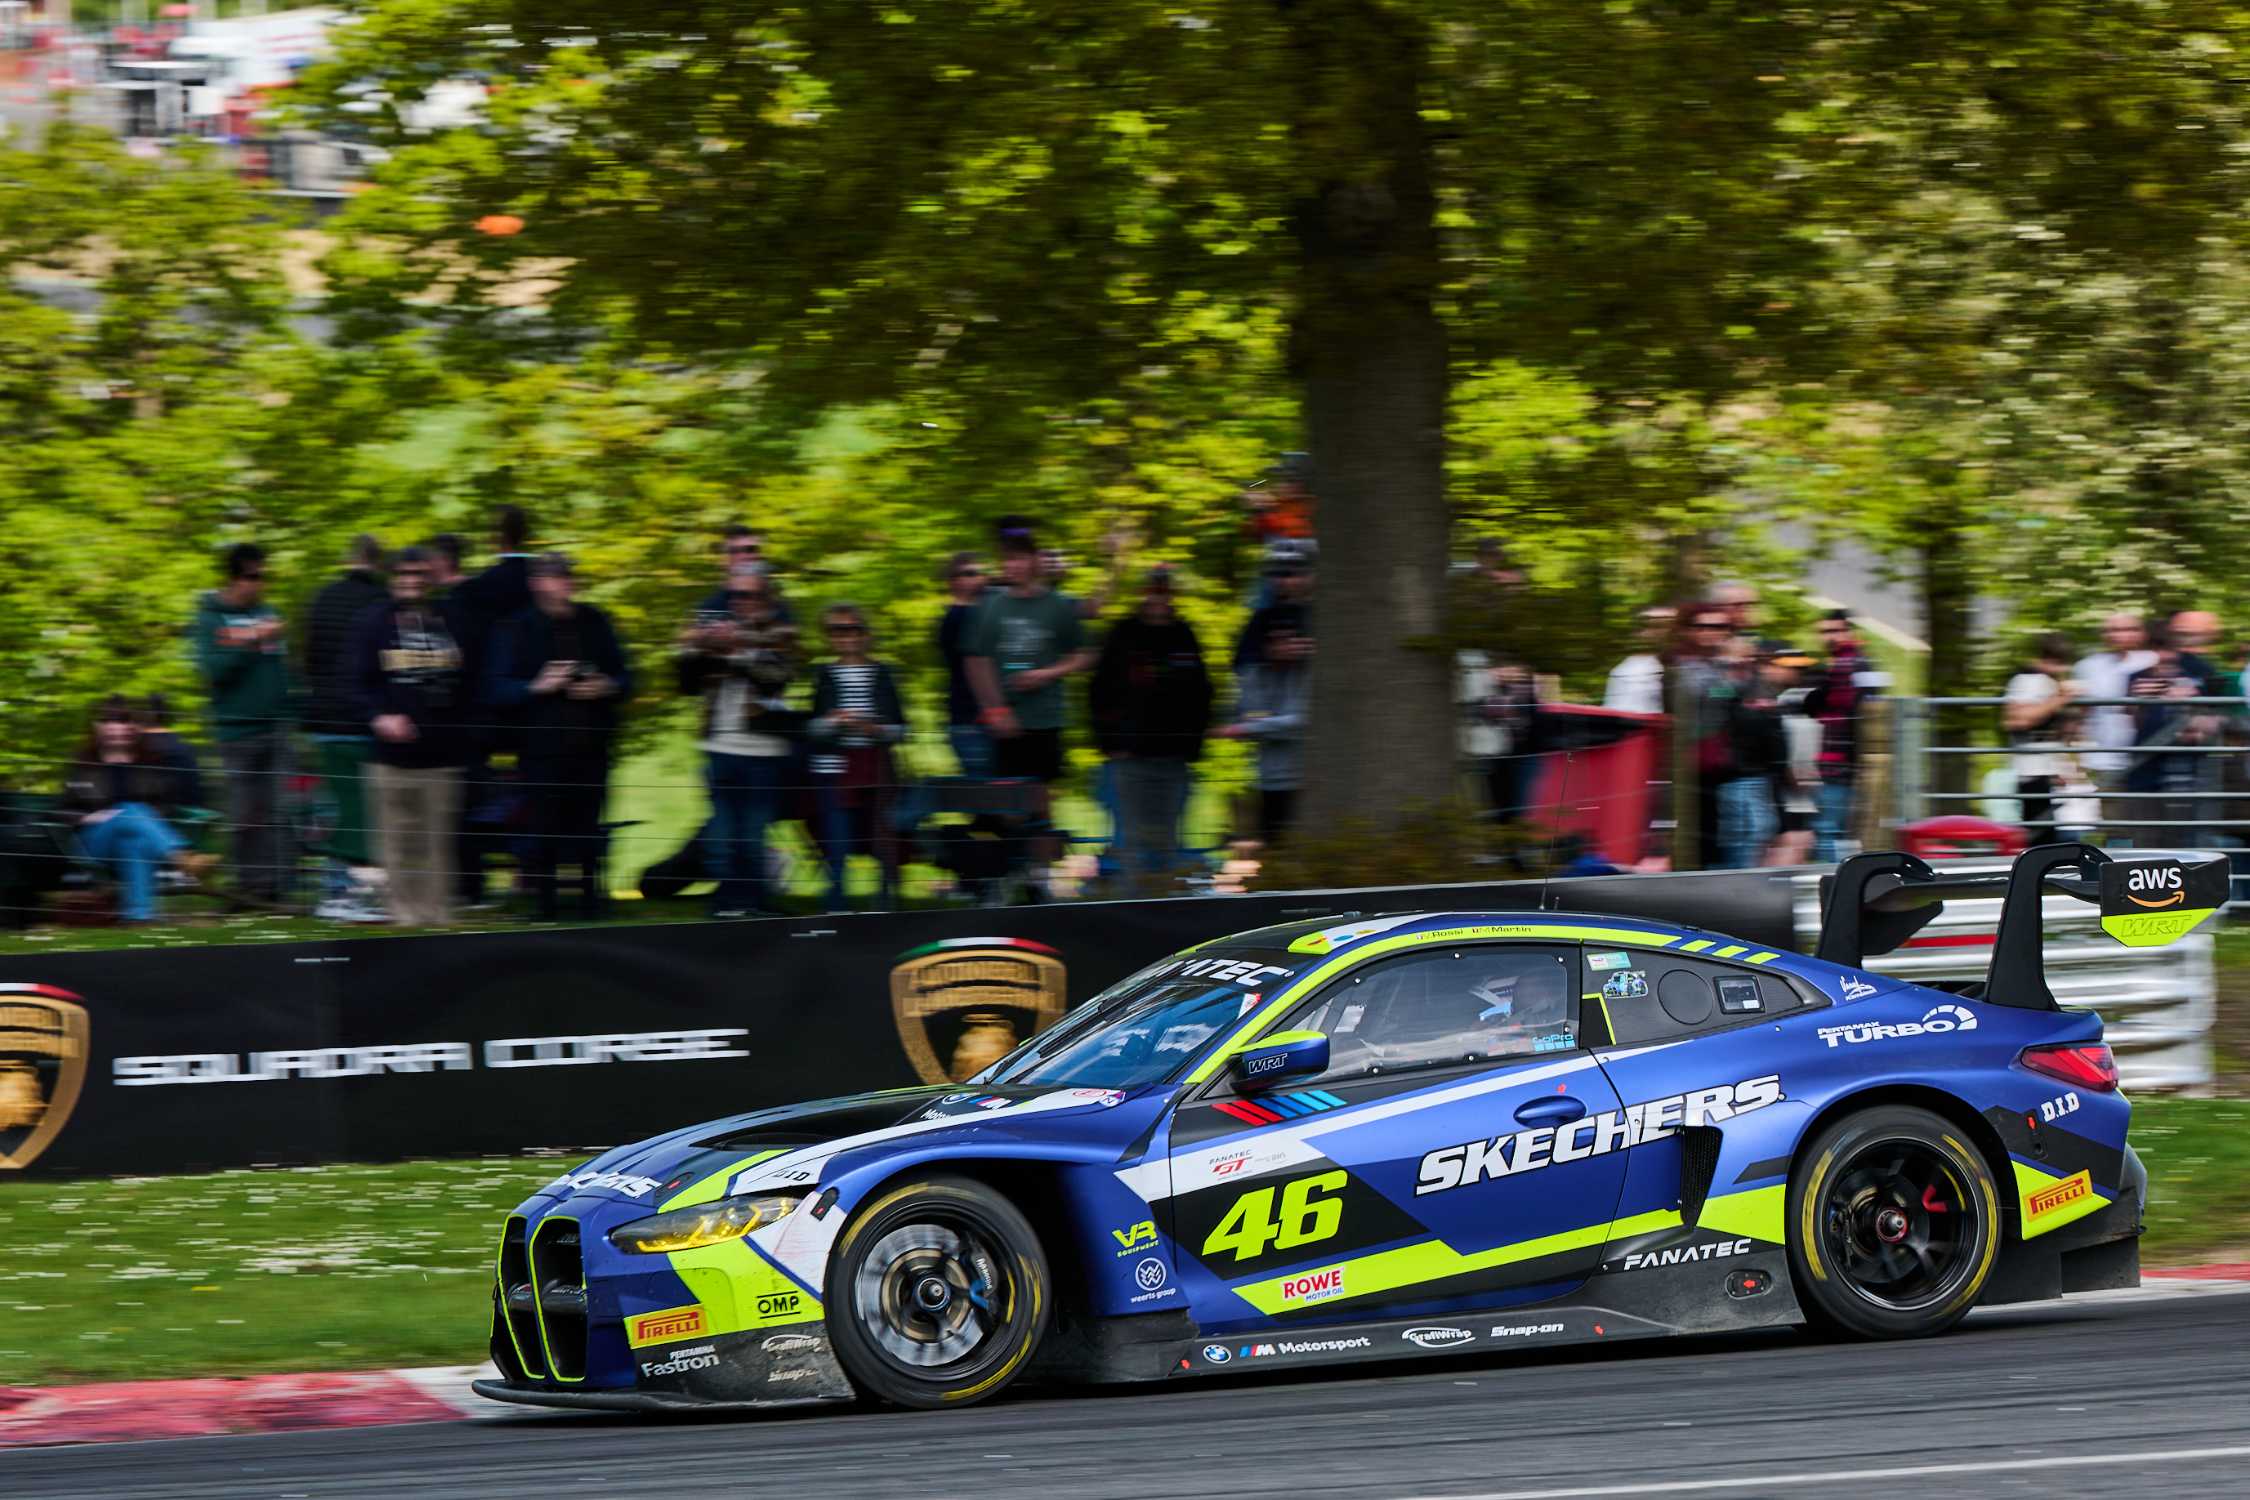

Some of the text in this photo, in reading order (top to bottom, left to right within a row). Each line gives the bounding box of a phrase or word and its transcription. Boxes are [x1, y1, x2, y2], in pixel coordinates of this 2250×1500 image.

[2128, 867, 2182, 891] aws
[2120, 915, 2192, 937] WRT
[1817, 1021, 1880, 1035] PERTAMAX
[1818, 1019, 1956, 1049] TURBO
[1249, 1053, 1288, 1074] WRT
[1415, 1074, 1781, 1197] SKECHERS
[1209, 1149, 1252, 1165] FANATEC
[1213, 1159, 1247, 1175] GT
[2029, 1177, 2085, 1214] PIRELLI
[1201, 1170, 1348, 1261] 46
[1112, 1220, 1158, 1248] VR
[1623, 1238, 1752, 1271] FANATEC
[1283, 1269, 1342, 1299] ROWE
[1305, 1287, 1344, 1301] MOTOR OIL
[757, 1296, 800, 1314] OMP
[638, 1311, 700, 1340] PIRELLI
[1491, 1323, 1565, 1337] Snap-on
[1278, 1336, 1372, 1355] Motorsport
[641, 1352, 720, 1378] Fastron
